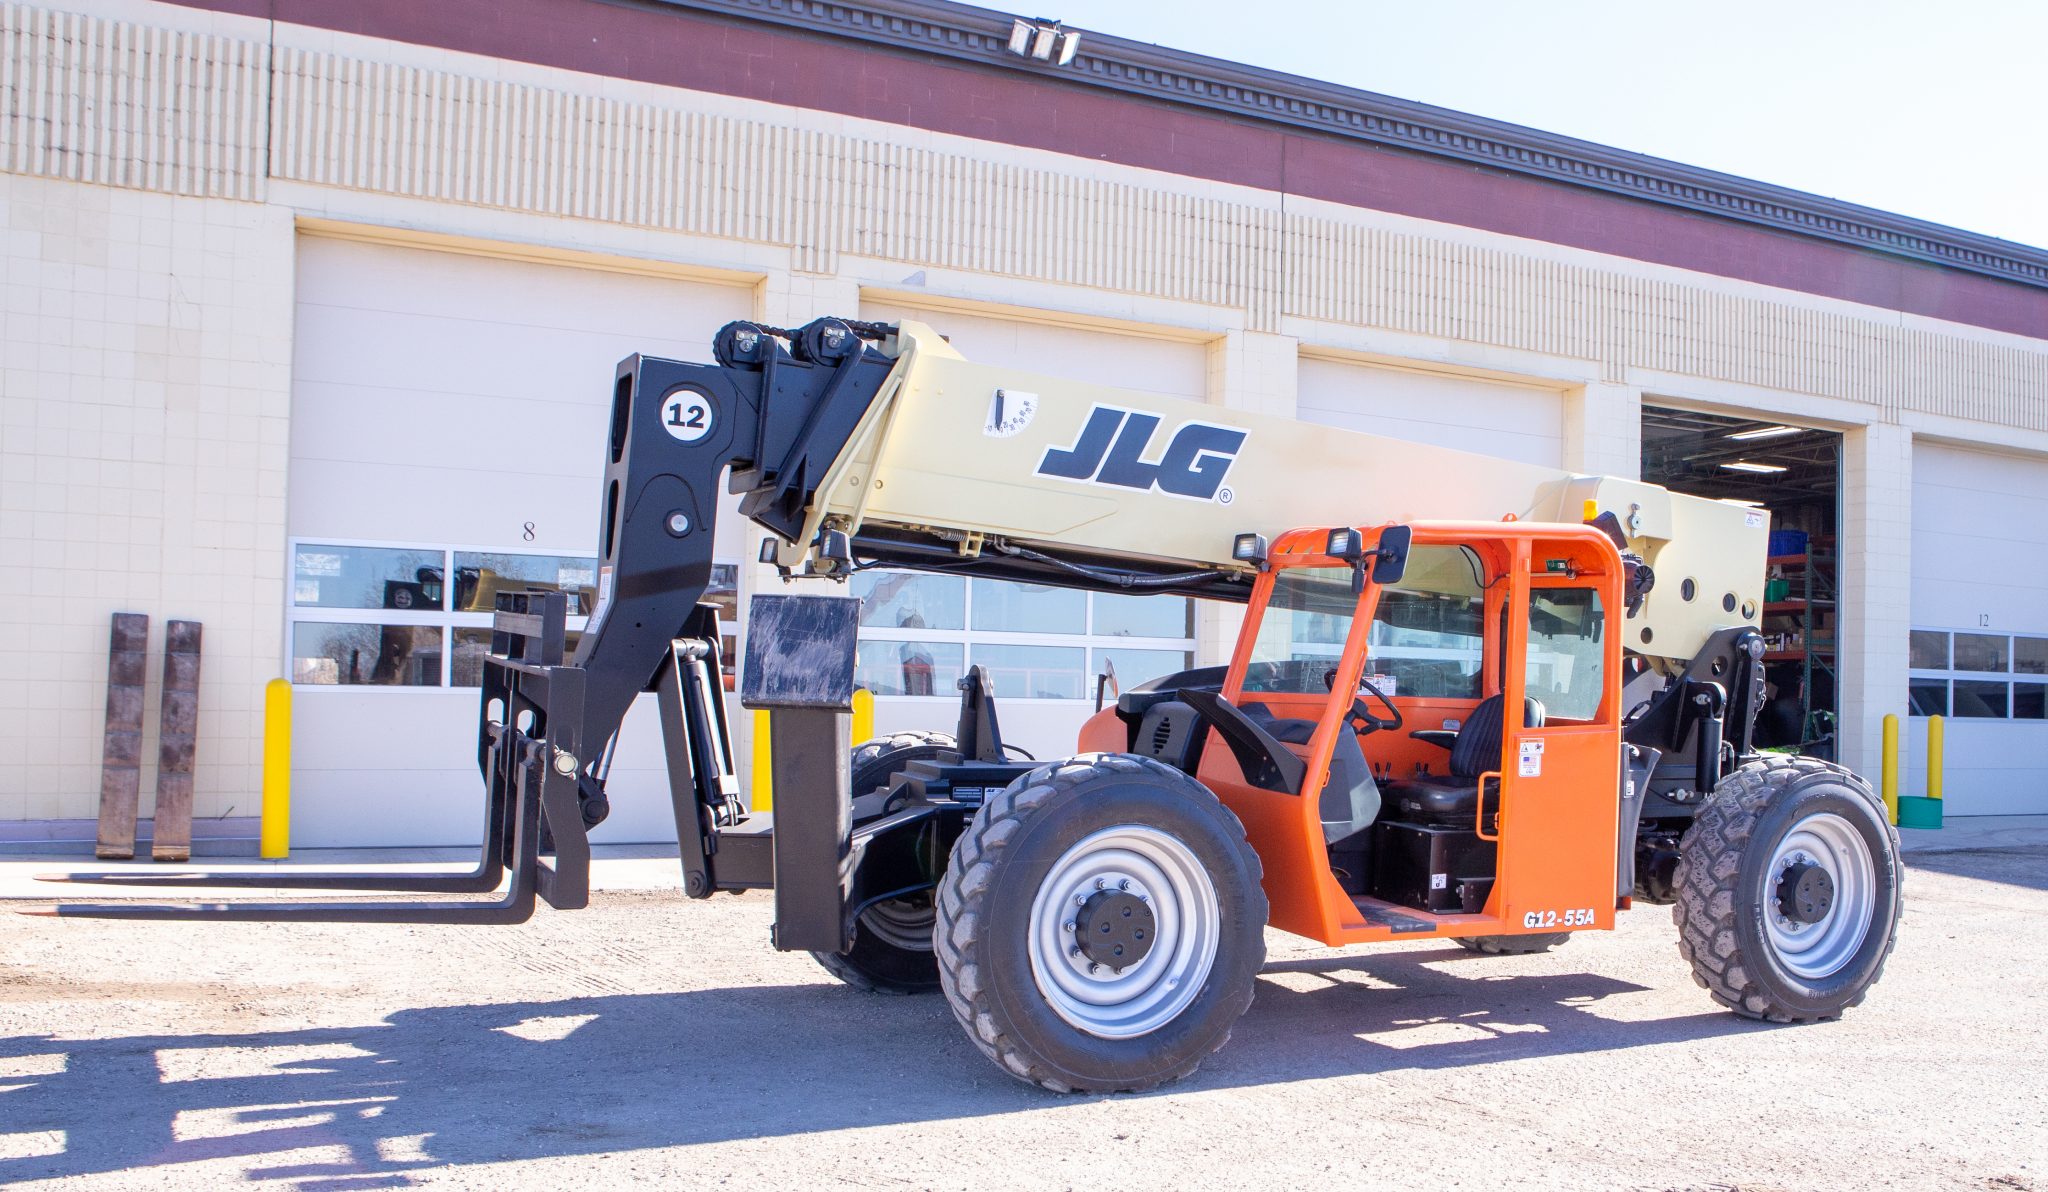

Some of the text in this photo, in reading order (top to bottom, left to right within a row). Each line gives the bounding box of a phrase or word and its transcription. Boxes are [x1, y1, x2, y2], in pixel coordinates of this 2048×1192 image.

[668, 403, 705, 429] 12
[1037, 406, 1247, 500] JLG
[523, 521, 535, 541] 8
[1979, 614, 1989, 627] 12
[1523, 908, 1595, 928] G12-55A
